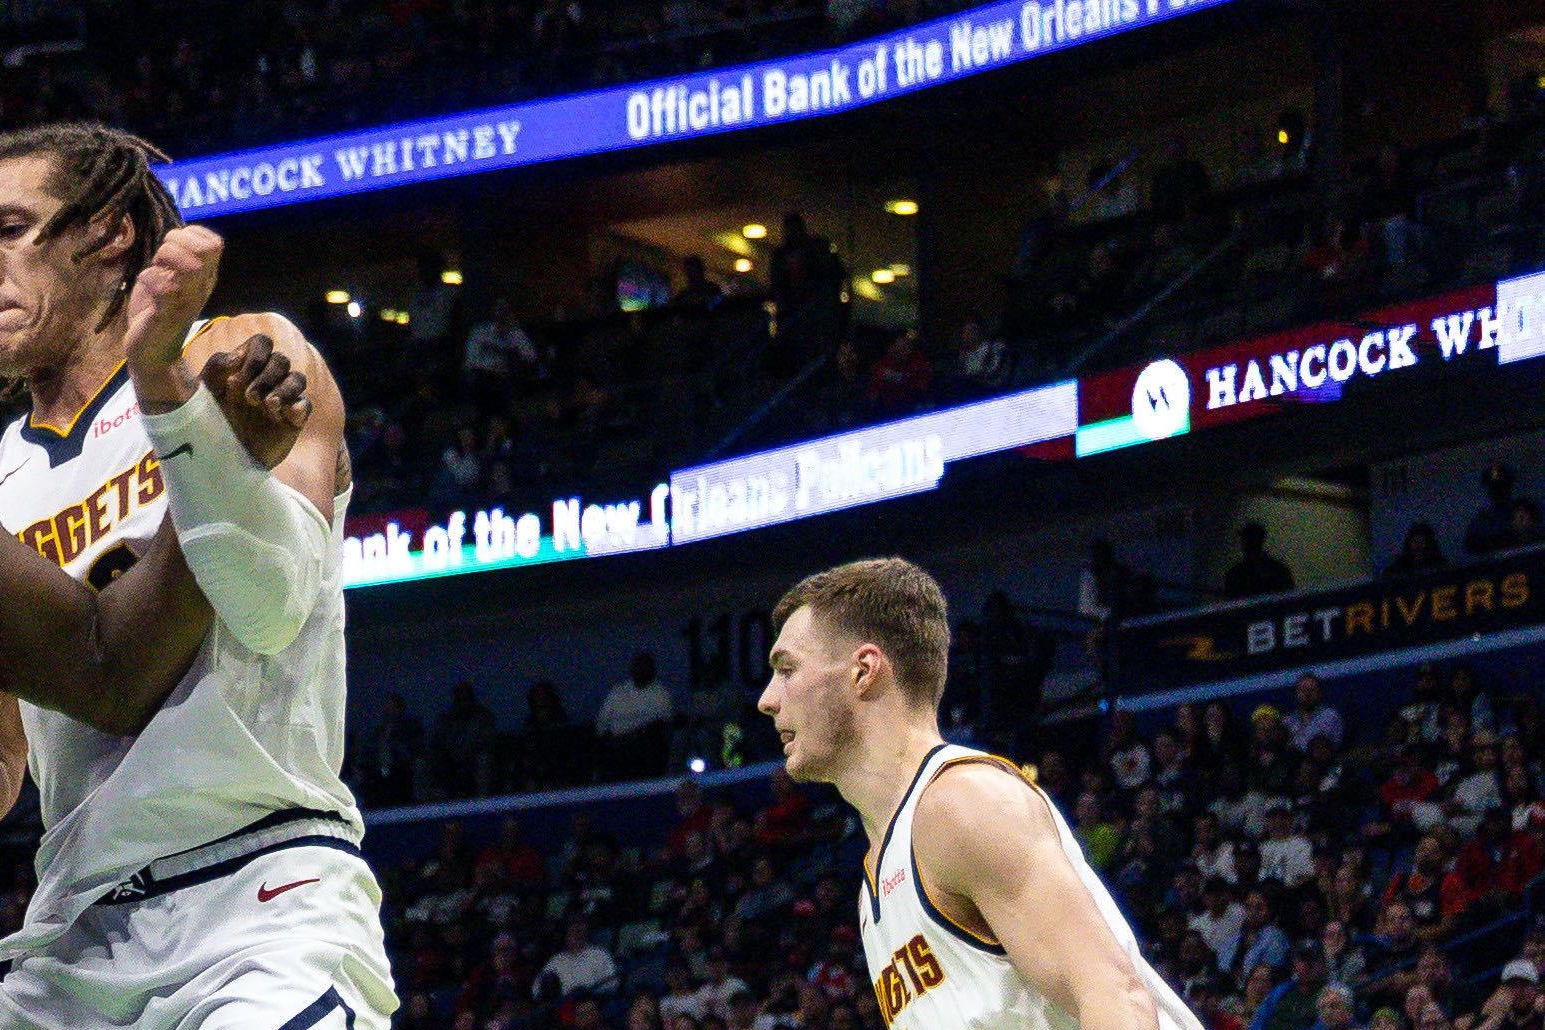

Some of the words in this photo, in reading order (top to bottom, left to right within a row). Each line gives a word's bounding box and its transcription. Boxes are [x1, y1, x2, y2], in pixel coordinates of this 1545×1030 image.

[627, 73, 754, 140] Official
[763, 59, 851, 118] Bank
[858, 45, 887, 99] of
[895, 38, 943, 88] the
[950, 20, 1014, 72] New
[1021, 0, 1139, 50] Orleans
[335, 120, 521, 182] WHITNEY
[1207, 323, 1418, 410] HANCOCK
[344, 521, 412, 574] ank
[422, 510, 467, 567] of
[474, 506, 541, 562] the
[552, 496, 642, 553] New
[1245, 570, 1530, 655] BETRIVERS
